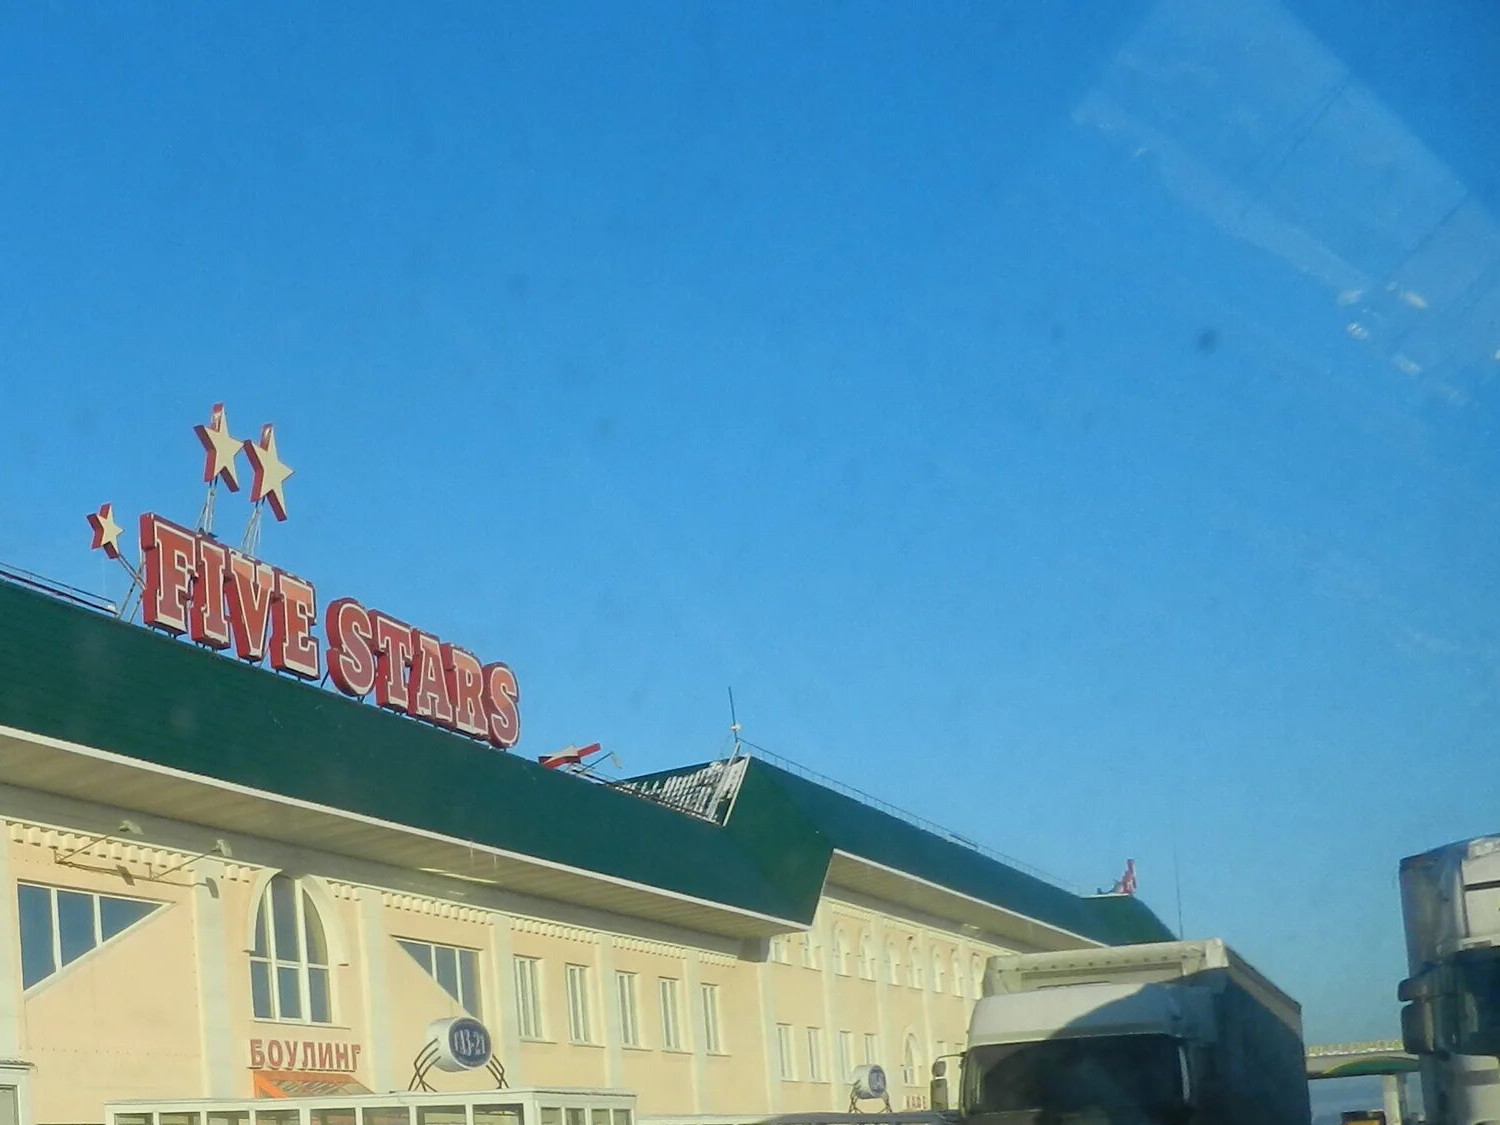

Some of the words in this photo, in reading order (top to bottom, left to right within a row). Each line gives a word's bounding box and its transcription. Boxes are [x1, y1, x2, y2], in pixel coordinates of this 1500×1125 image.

[140, 513, 319, 681] FIVE
[326, 597, 520, 749] STARS
[249, 1039, 361, 1071] БОУЛИНГ
